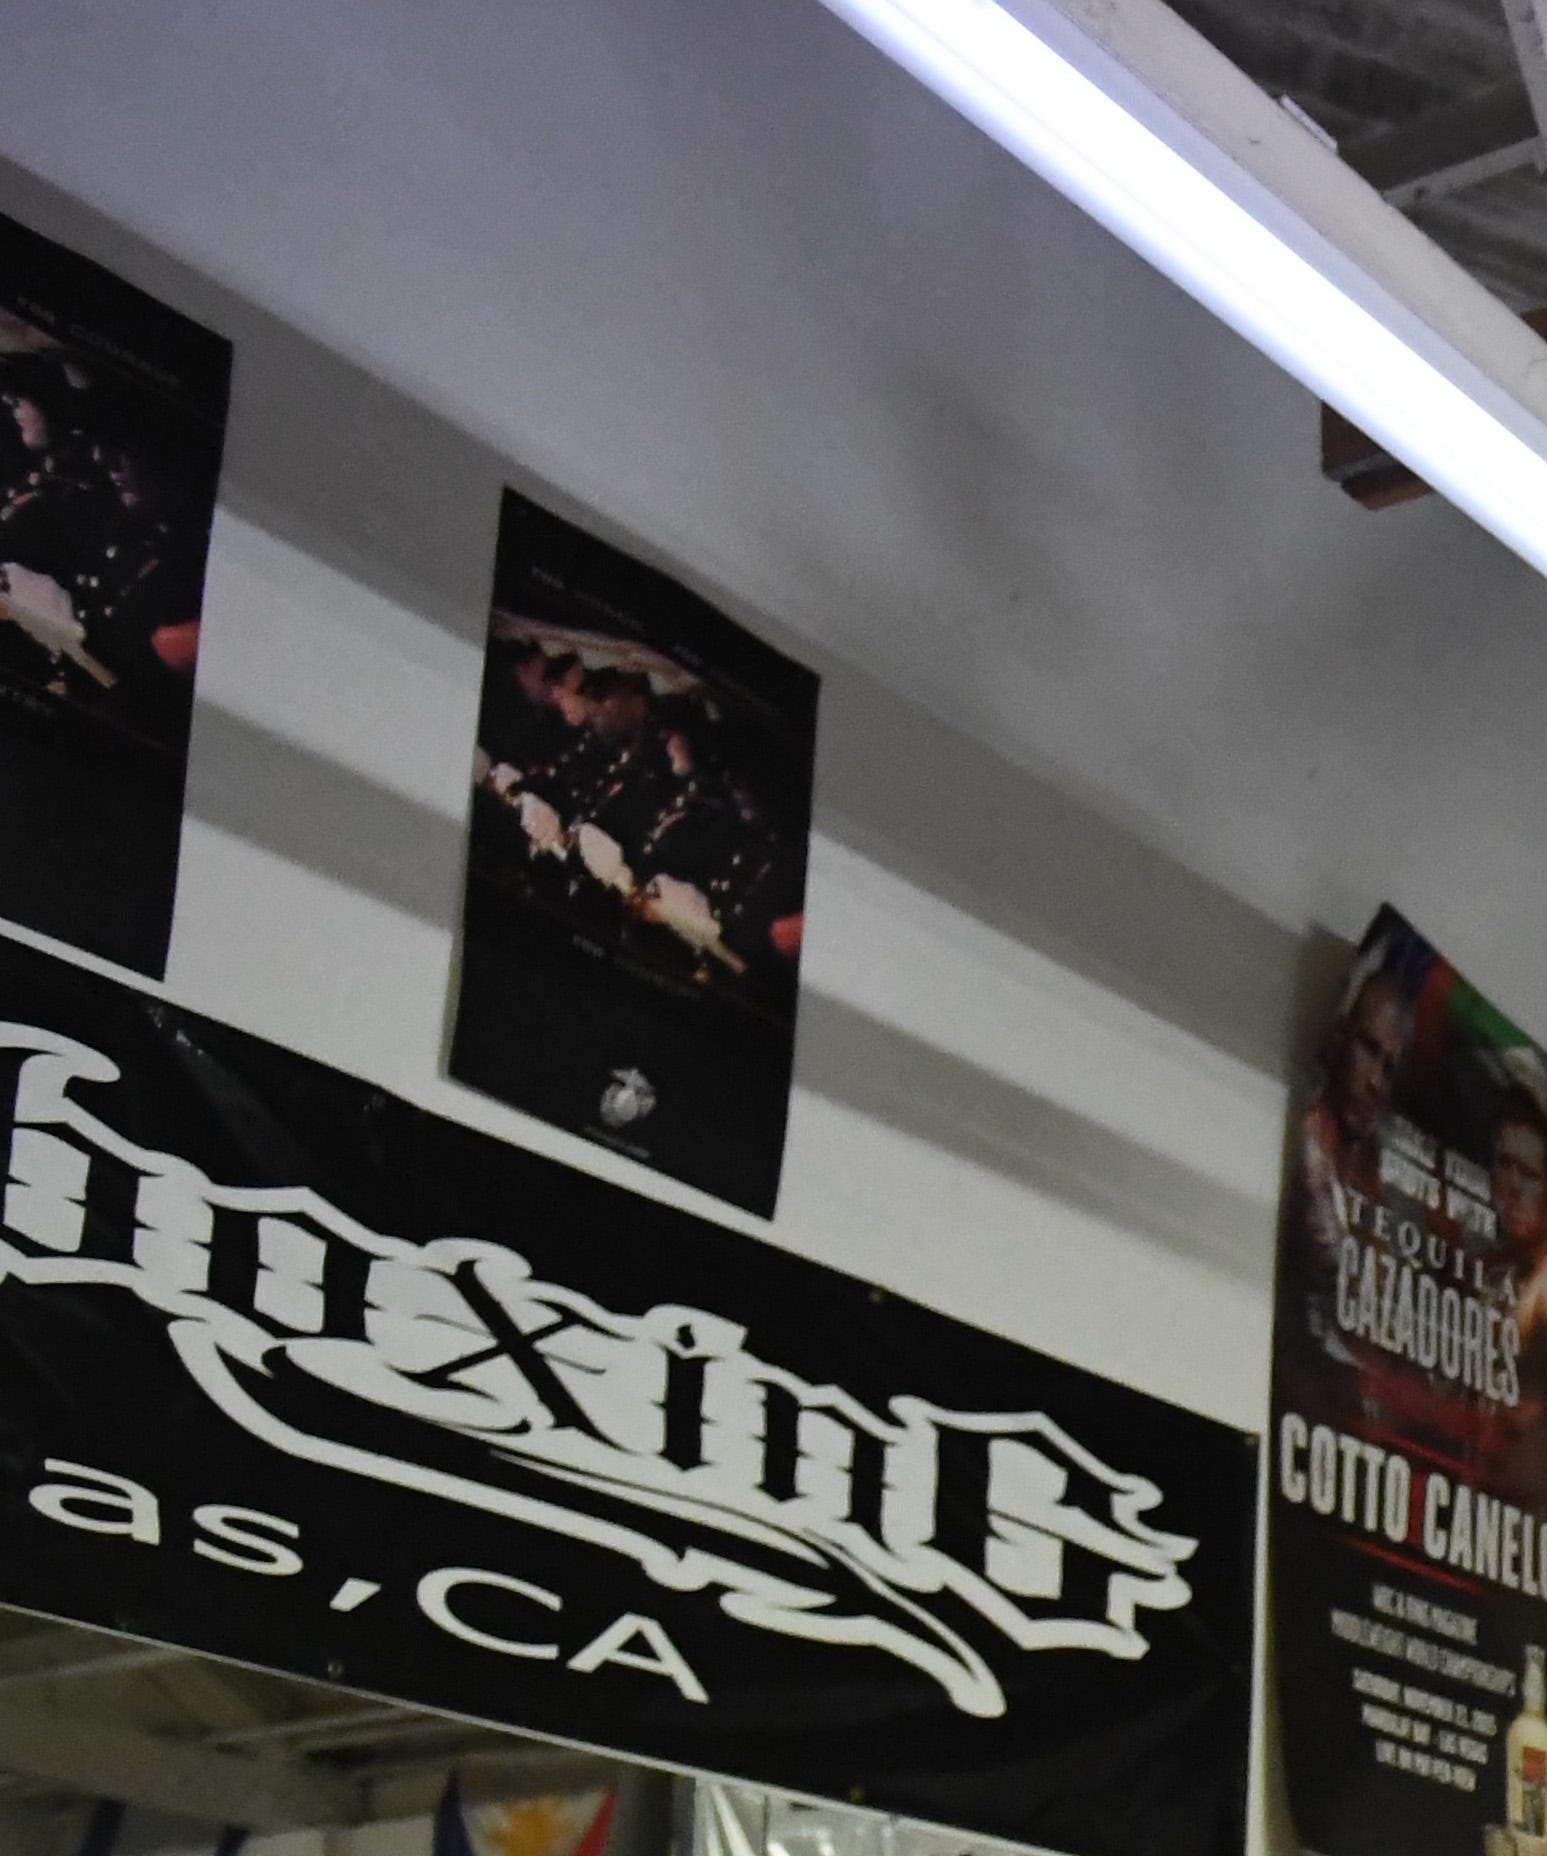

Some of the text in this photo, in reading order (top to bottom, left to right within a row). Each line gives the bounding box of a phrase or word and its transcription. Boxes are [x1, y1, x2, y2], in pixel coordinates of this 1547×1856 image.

[1347, 1187, 1517, 1308] TEQUILA
[1336, 1237, 1520, 1407] CAZADORES
[1280, 1413, 1411, 1544] COTTO
